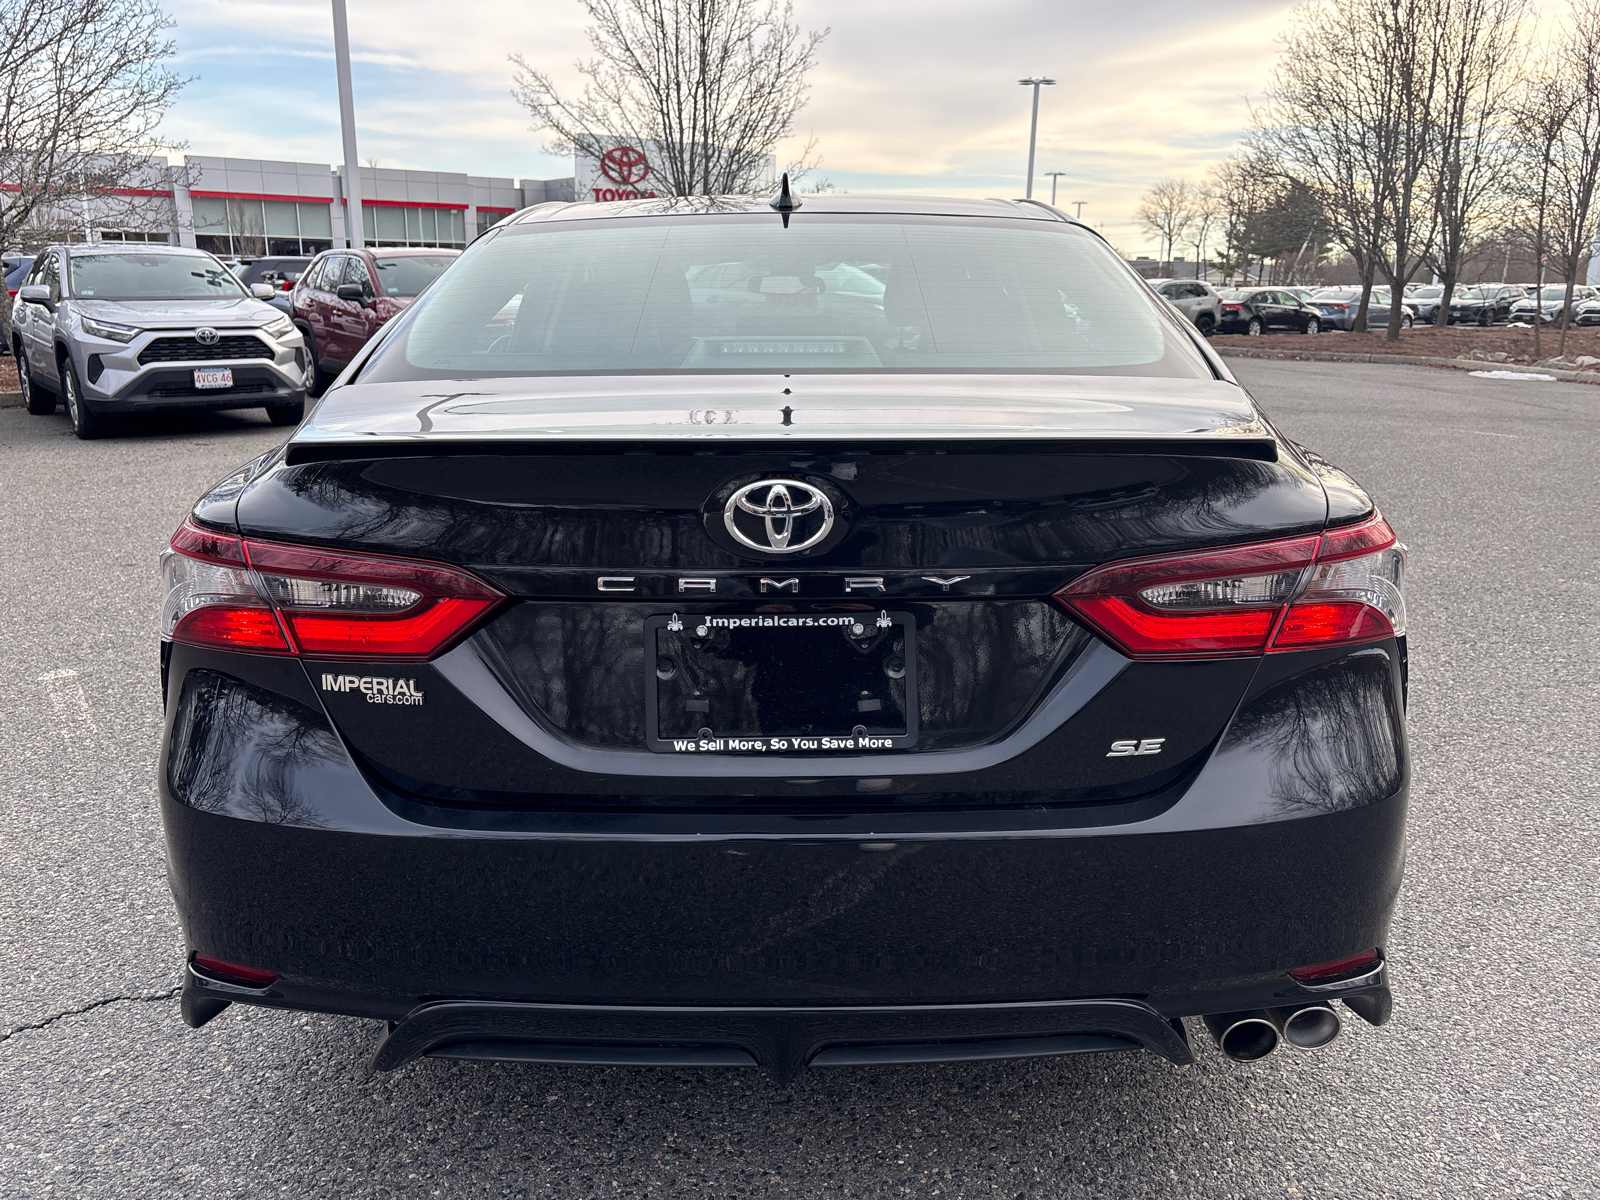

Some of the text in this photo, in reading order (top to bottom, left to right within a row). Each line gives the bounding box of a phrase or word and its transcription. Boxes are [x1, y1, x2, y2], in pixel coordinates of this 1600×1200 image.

[592, 188, 655, 202] TOYO
[196, 372, 232, 383] 4VCG 46
[597, 576, 971, 593] CAMRY
[705, 616, 855, 629] Imperialcars.com
[321, 673, 424, 697] IMPERIAL
[366, 693, 424, 706] cars.com
[673, 737, 893, 752] We Sell More, So You Save More
[1105, 738, 1166, 757] SE
